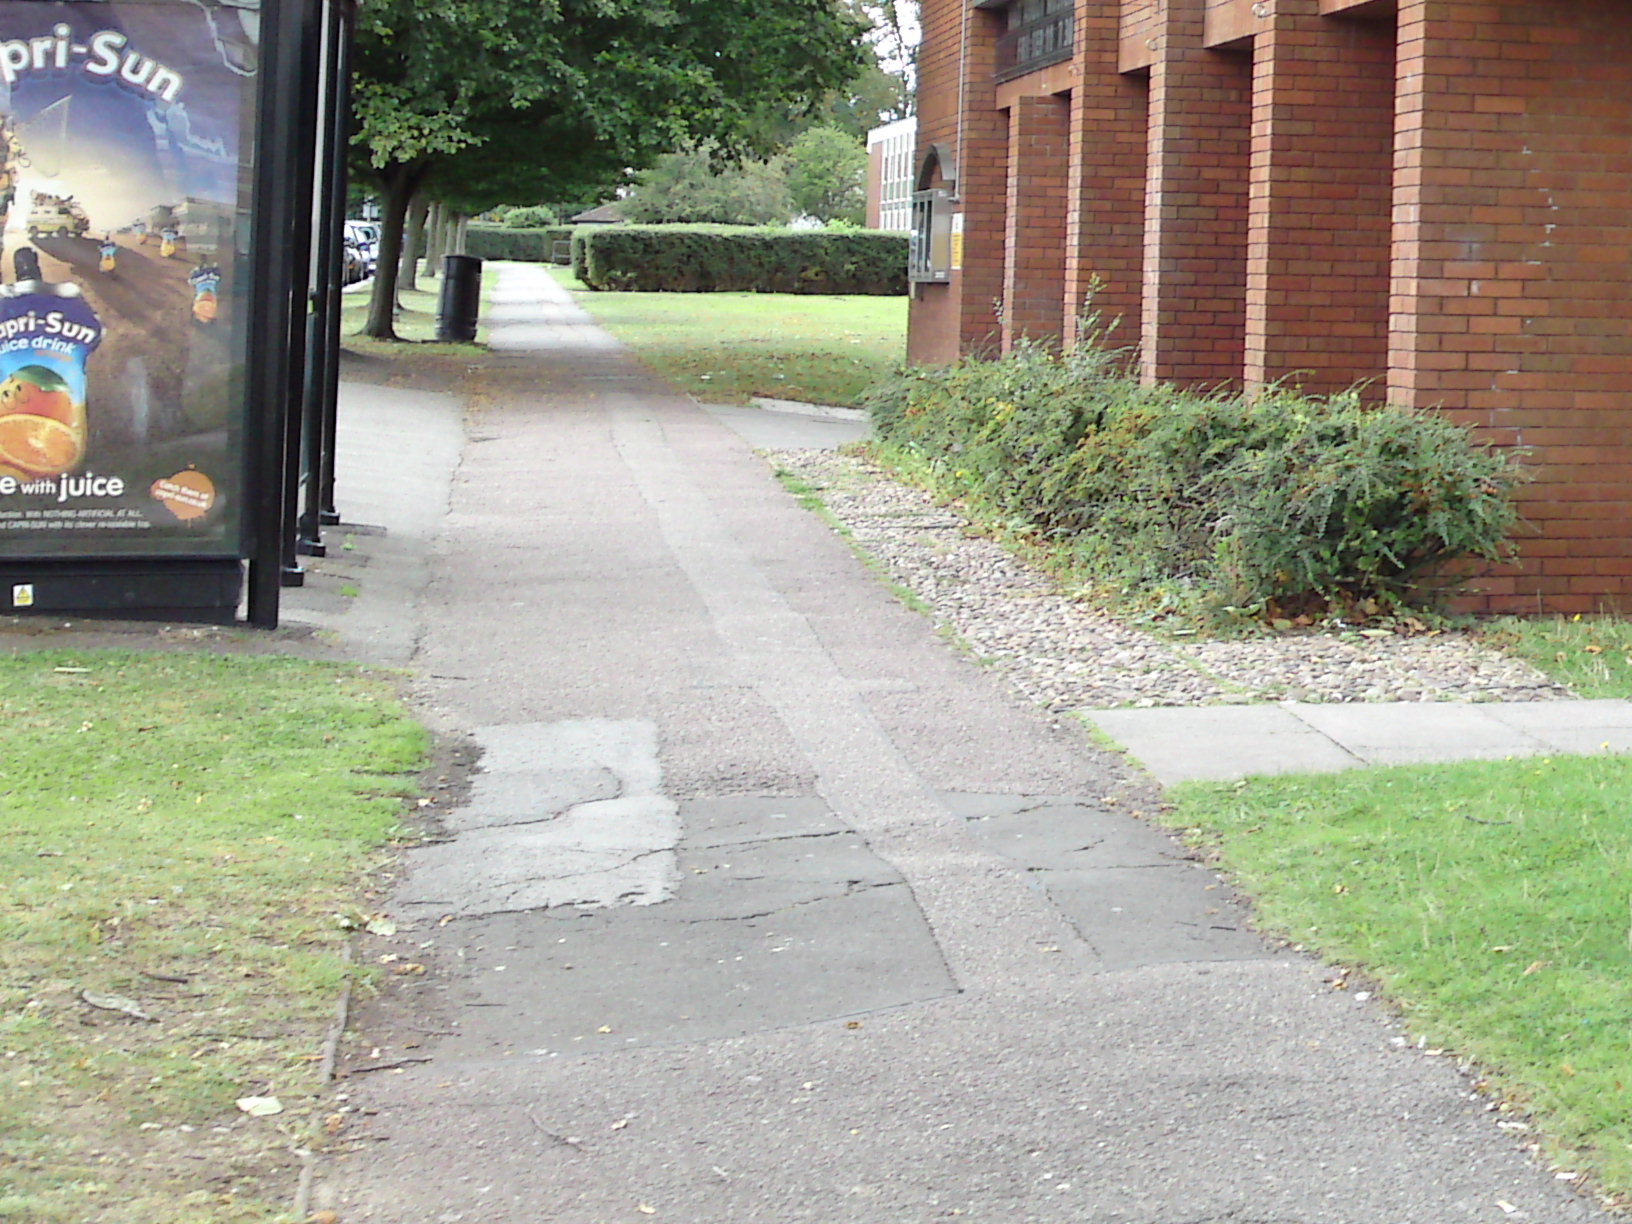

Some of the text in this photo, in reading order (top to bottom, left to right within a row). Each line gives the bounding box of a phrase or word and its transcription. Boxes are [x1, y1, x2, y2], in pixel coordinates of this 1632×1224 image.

[31, 335, 77, 355] drink
[20, 478, 57, 495] with
[56, 470, 125, 503] juice
